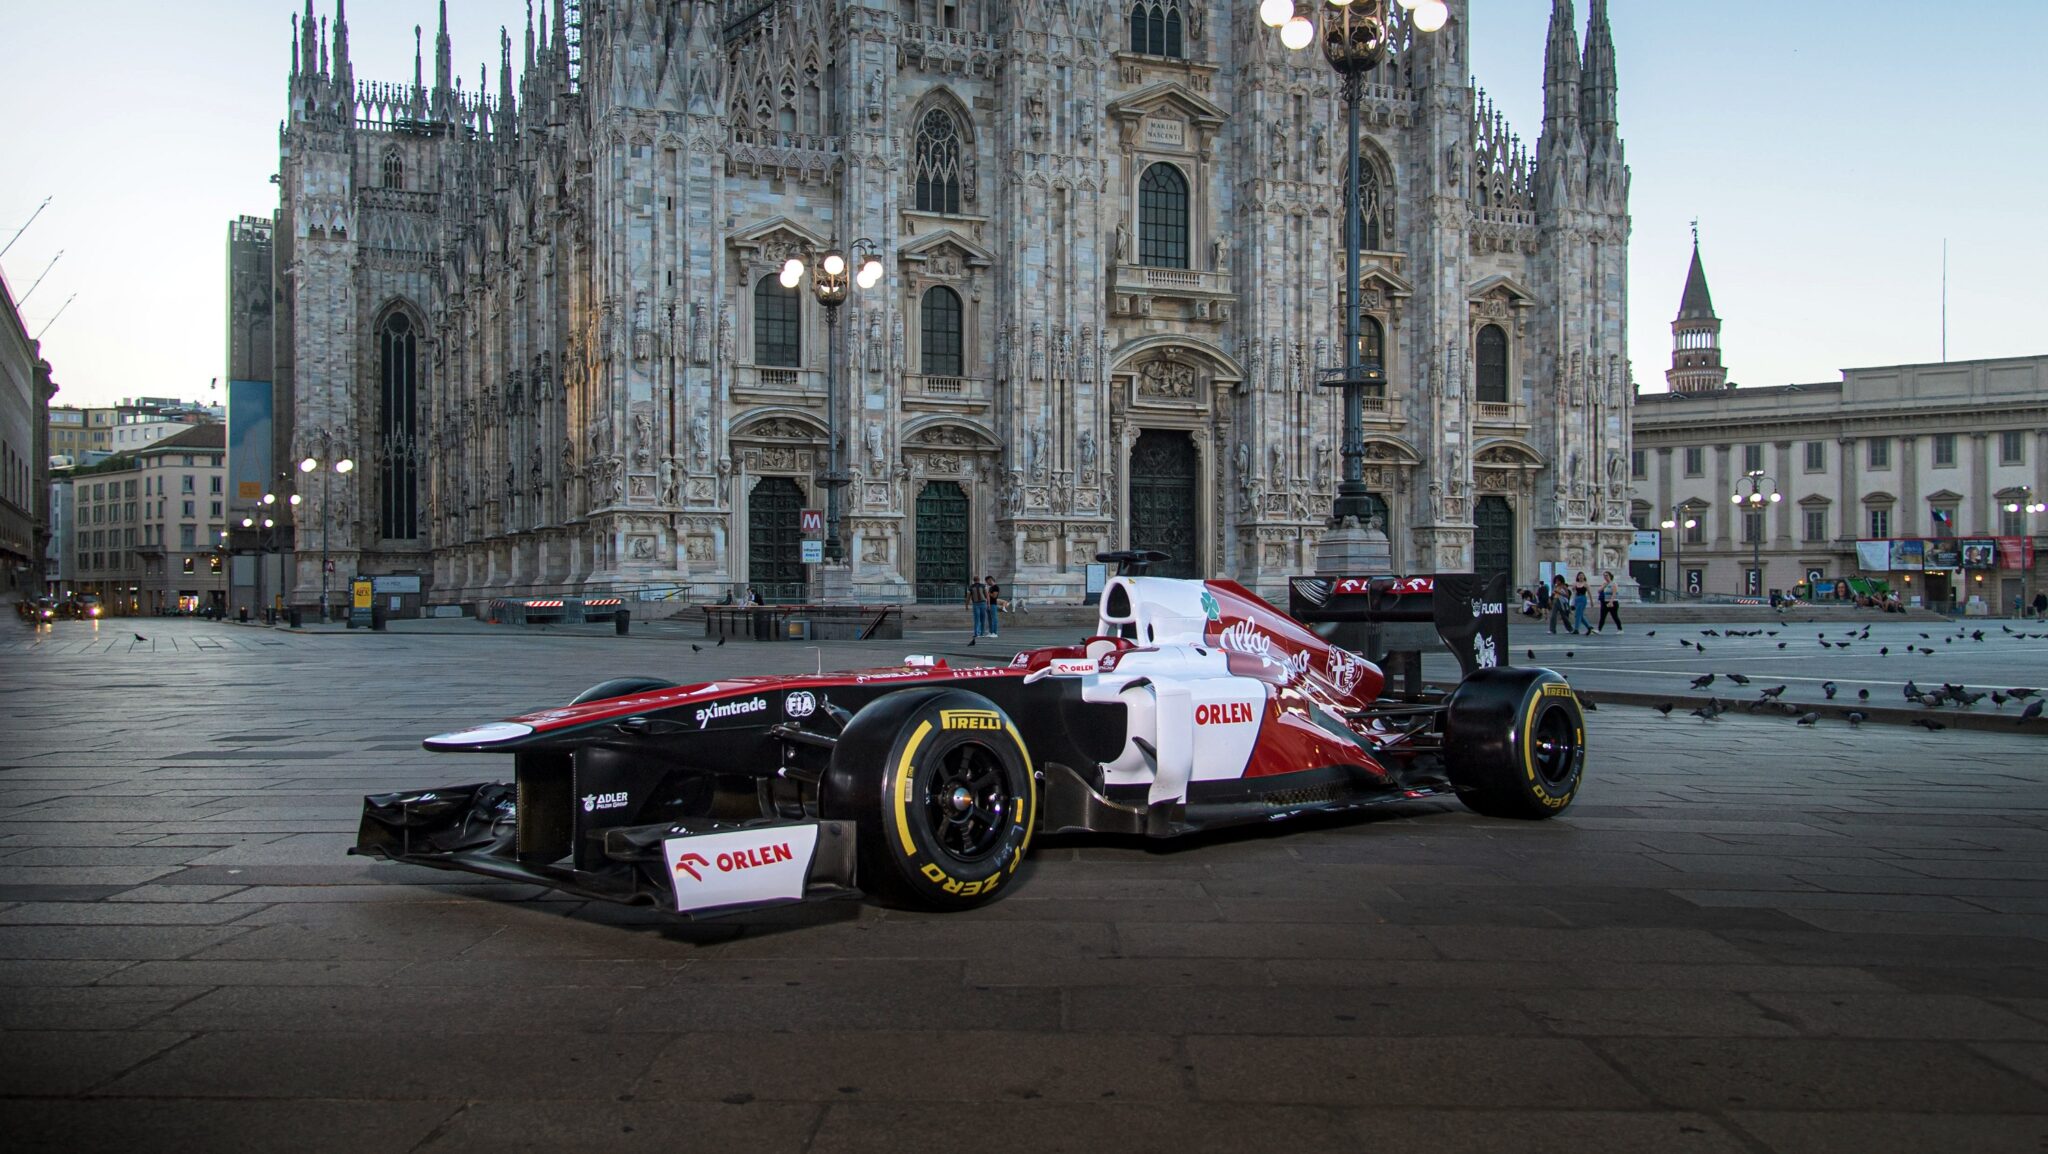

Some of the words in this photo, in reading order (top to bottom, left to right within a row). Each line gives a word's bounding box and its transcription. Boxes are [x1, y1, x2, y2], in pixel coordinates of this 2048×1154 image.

[1148, 131, 1180, 140] NASCENTI
[803, 513, 821, 529] M
[1481, 603, 1503, 614] FLOKI
[953, 669, 1005, 678] EYEWEAR
[1070, 664, 1094, 672] ORLEN
[1542, 682, 1572, 697] PIRELLI
[787, 696, 813, 712] FIA
[696, 697, 767, 729] aximtrade
[940, 709, 1002, 730] PIRELLI
[1195, 702, 1253, 725] ORLEN
[597, 792, 628, 804] ADLER
[717, 843, 793, 872] ORLEN
[921, 863, 1001, 896] ZERO
